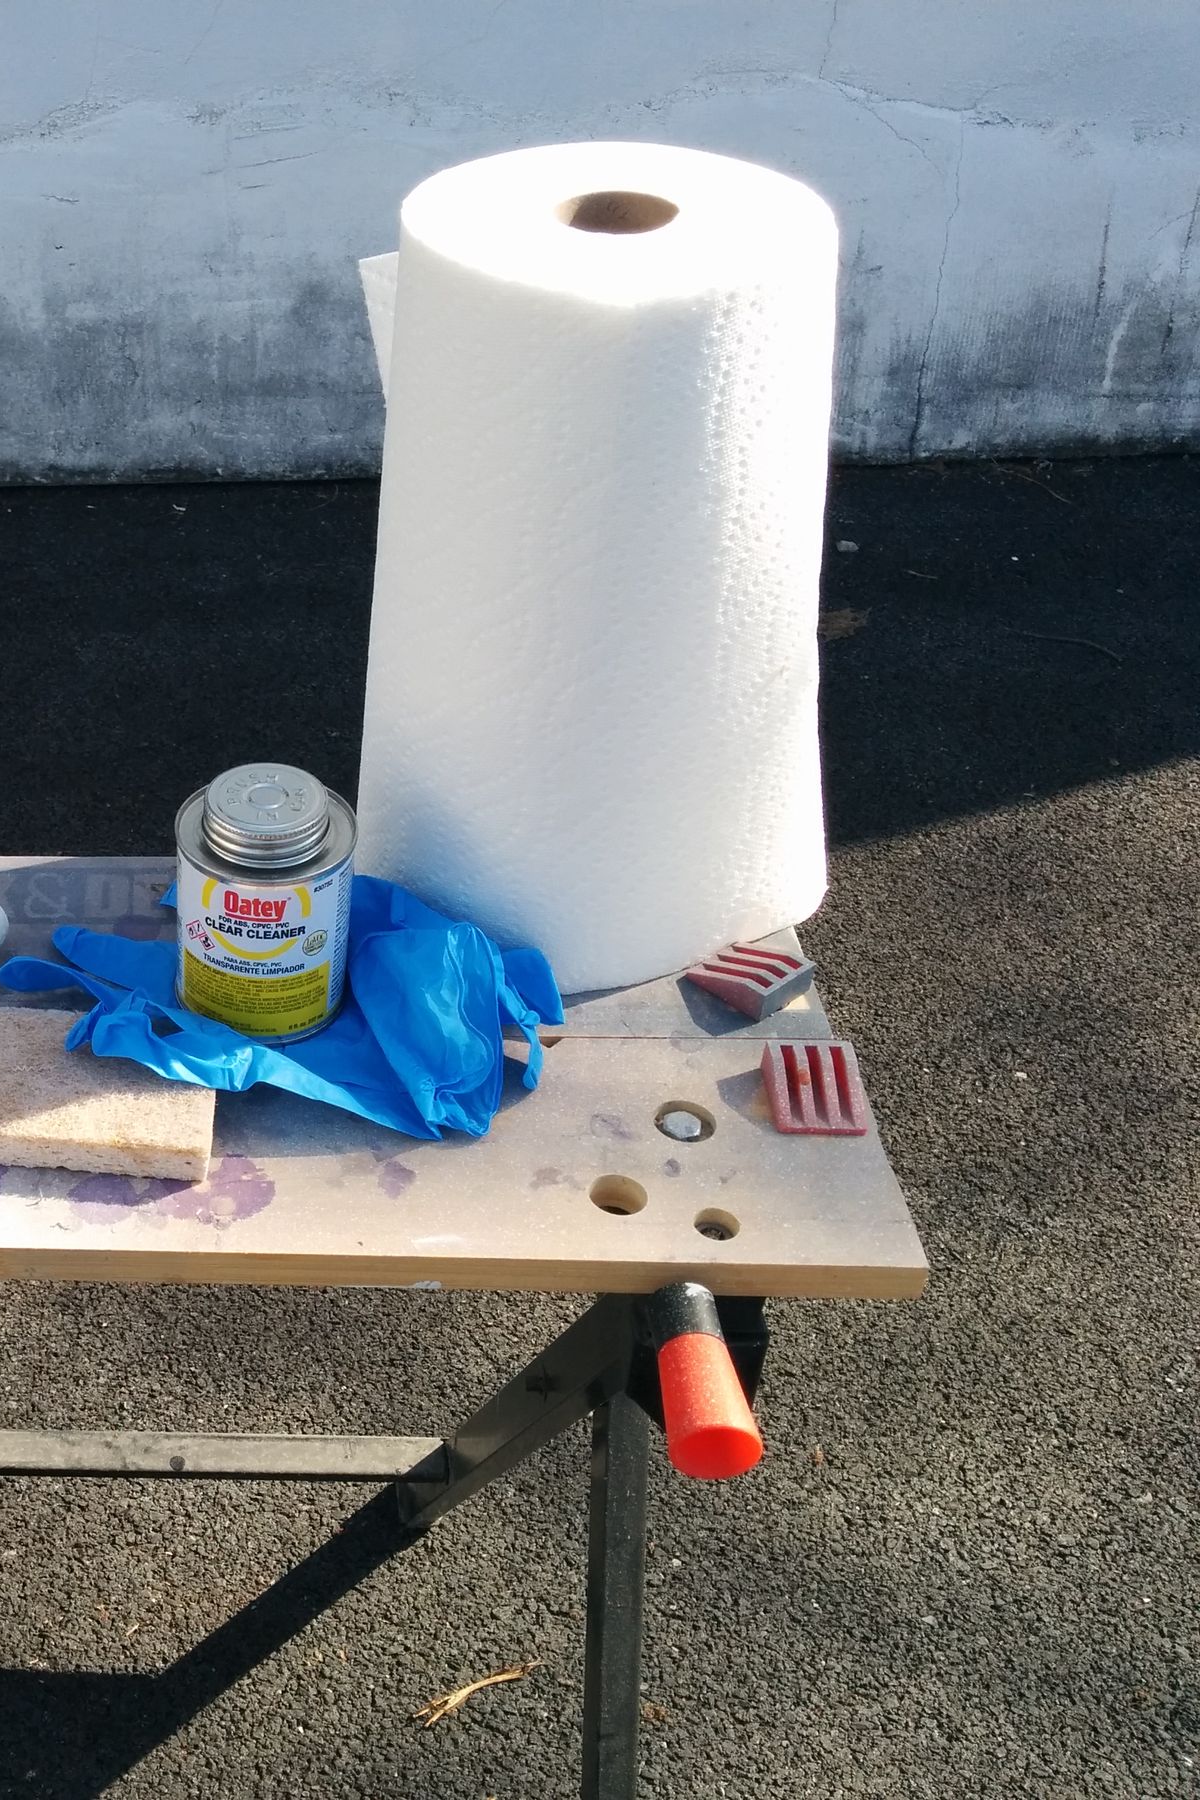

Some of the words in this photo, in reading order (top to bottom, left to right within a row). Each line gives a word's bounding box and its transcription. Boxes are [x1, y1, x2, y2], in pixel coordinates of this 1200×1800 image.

[224, 890, 287, 922] Oatey
[205, 916, 243, 938] CLEAR
[246, 926, 306, 940] CLEANER
[219, 915, 232, 924] FOR
[233, 920, 250, 929] ABS,
[252, 922, 274, 930] CPVC,
[203, 953, 260, 975] TRANSPARENTE
[261, 963, 305, 975] LIMPIADOR
[223, 956, 238, 964] PARA
